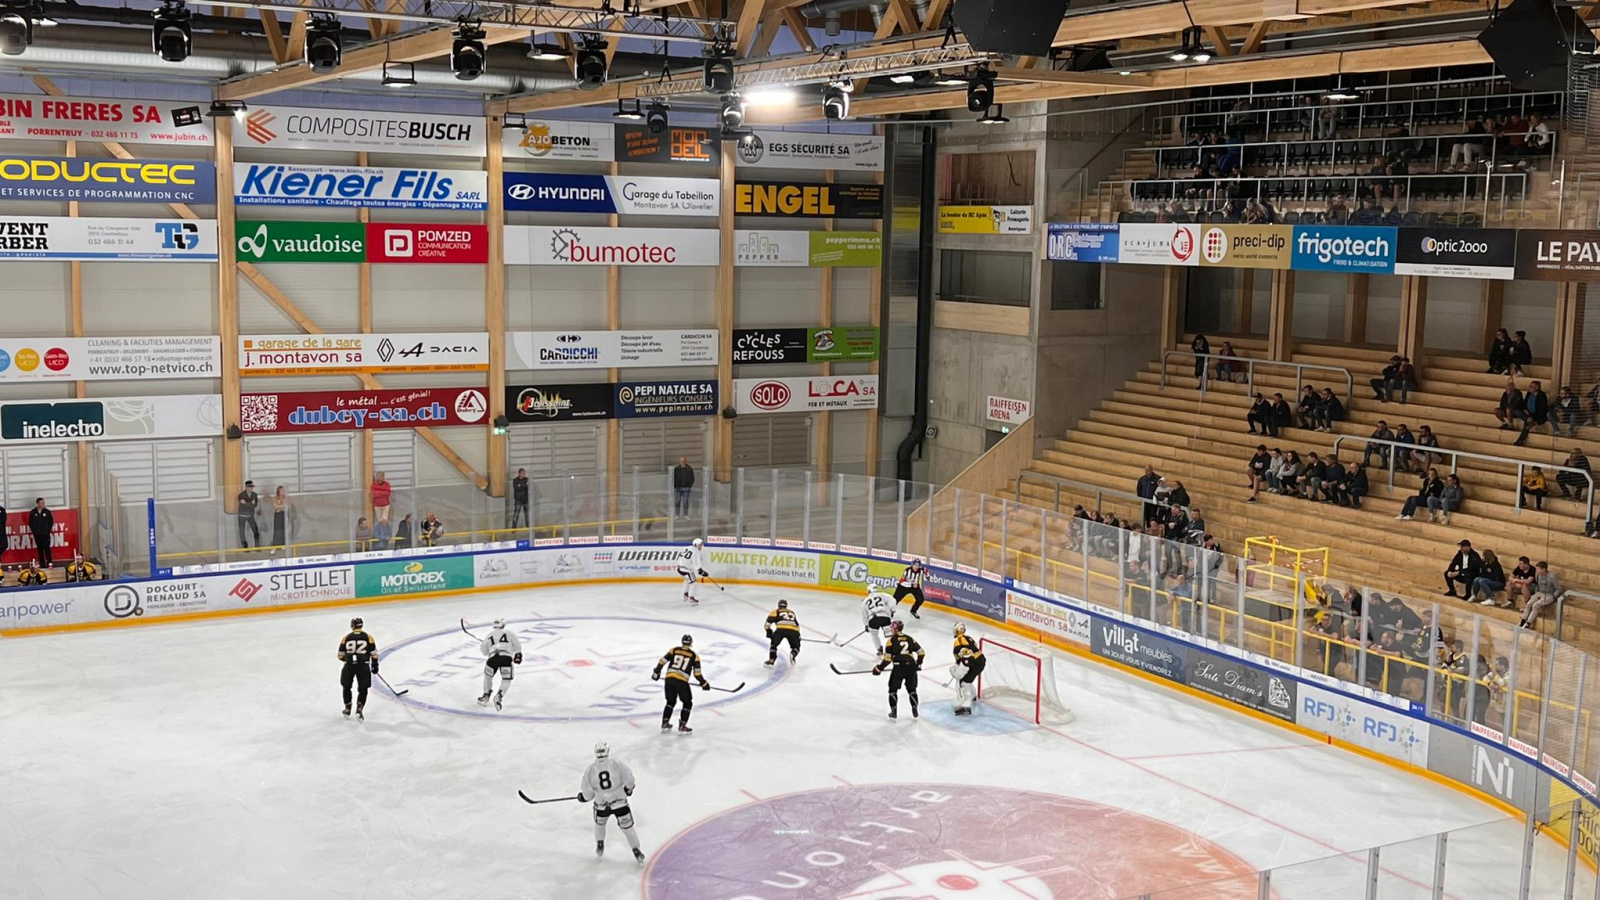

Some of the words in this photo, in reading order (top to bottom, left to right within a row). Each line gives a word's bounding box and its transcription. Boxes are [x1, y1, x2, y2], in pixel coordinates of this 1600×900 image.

[42, 101, 123, 122] FRERES
[132, 105, 162, 123] SA
[28, 128, 82, 138] PORRENTRUY
[150, 132, 208, 142] www.jubin.ch
[769, 143, 788, 152] EGS
[791, 142, 835, 154] SÉCURITÉ
[838, 146, 850, 155] SA
[241, 164, 383, 198] Kiener
[391, 170, 453, 200] Fils
[455, 191, 481, 200] SARL
[1, 188, 13, 196] ET
[18, 188, 64, 197] SERVICES
[68, 189, 80, 198] DE
[84, 190, 171, 199] PROGRAMMATION
[174, 192, 194, 200] CNC
[538, 186, 604, 200] HYUNDAI
[662, 190, 674, 200] du
[675, 190, 714, 200] Tabeillon
[735, 184, 836, 215] ENGEL
[326, 198, 362, 206] Chauffage
[422, 202, 460, 210] Dépannage
[272, 234, 362, 253] vaudoise
[418, 231, 472, 242] POMZED
[1233, 234, 1285, 250] preci-dip
[570, 239, 676, 263] bumotec
[1298, 232, 1388, 263] frigotech
[1428, 238, 1458, 256] Optic
[1458, 240, 1488, 254] 2000
[1537, 241, 1562, 262] LE
[88, 339, 122, 347] CLEANING
[130, 338, 163, 346] FACILITIES
[258, 339, 300, 350] garage
[302, 338, 318, 348] de
[322, 338, 333, 348] la
[336, 338, 362, 348] gare
[738, 332, 781, 348] CYCLES
[260, 352, 339, 364] montavon
[345, 352, 362, 362] sa
[540, 347, 598, 360] CARDICCHI
[734, 349, 784, 360] REFOUSS
[89, 362, 213, 376] www.top-netvico.ch
[634, 386, 656, 396] PEPI
[658, 384, 697, 395] NATALE
[700, 384, 713, 394] SA
[755, 387, 786, 404] SOLO
[862, 386, 876, 396] SA
[336, 396, 346, 406] le
[349, 396, 378, 406] métal
[990, 398, 1026, 412] RAIFFEISEN
[289, 402, 447, 428] dubey-sa.ch
[635, 404, 714, 414] www.pepinatale.ch
[990, 410, 1010, 420] ARENA
[22, 420, 102, 438] inelectro
[710, 552, 768, 566] WALTER
[771, 554, 816, 570] MEIER
[756, 568, 790, 577] solutions
[792, 570, 806, 578] that
[808, 571, 816, 579] fit
[831, 560, 867, 582] RG
[381, 570, 444, 588] MOTOREX
[146, 582, 196, 594] DOCOURT
[270, 587, 350, 600] MICROTECHNIQUE
[404, 582, 446, 592] Switzerland
[963, 580, 984, 594] Acifer
[146, 592, 188, 602] RENAUD
[194, 590, 206, 598] SA
[866, 596, 882, 610] 22
[1014, 608, 1056, 627] montavon
[1058, 621, 1068, 632] sa
[488, 633, 508, 646] 14
[1102, 625, 1140, 654] Villat
[1140, 644, 1173, 664] meubles
[346, 640, 368, 654] 92
[672, 654, 690, 671] 91
[1126, 656, 1140, 666] VOUS
[1472, 724, 1503, 742] RAIFFEISEN
[1509, 739, 1538, 758] RAIFFEISEN
[598, 770, 612, 790] 8
